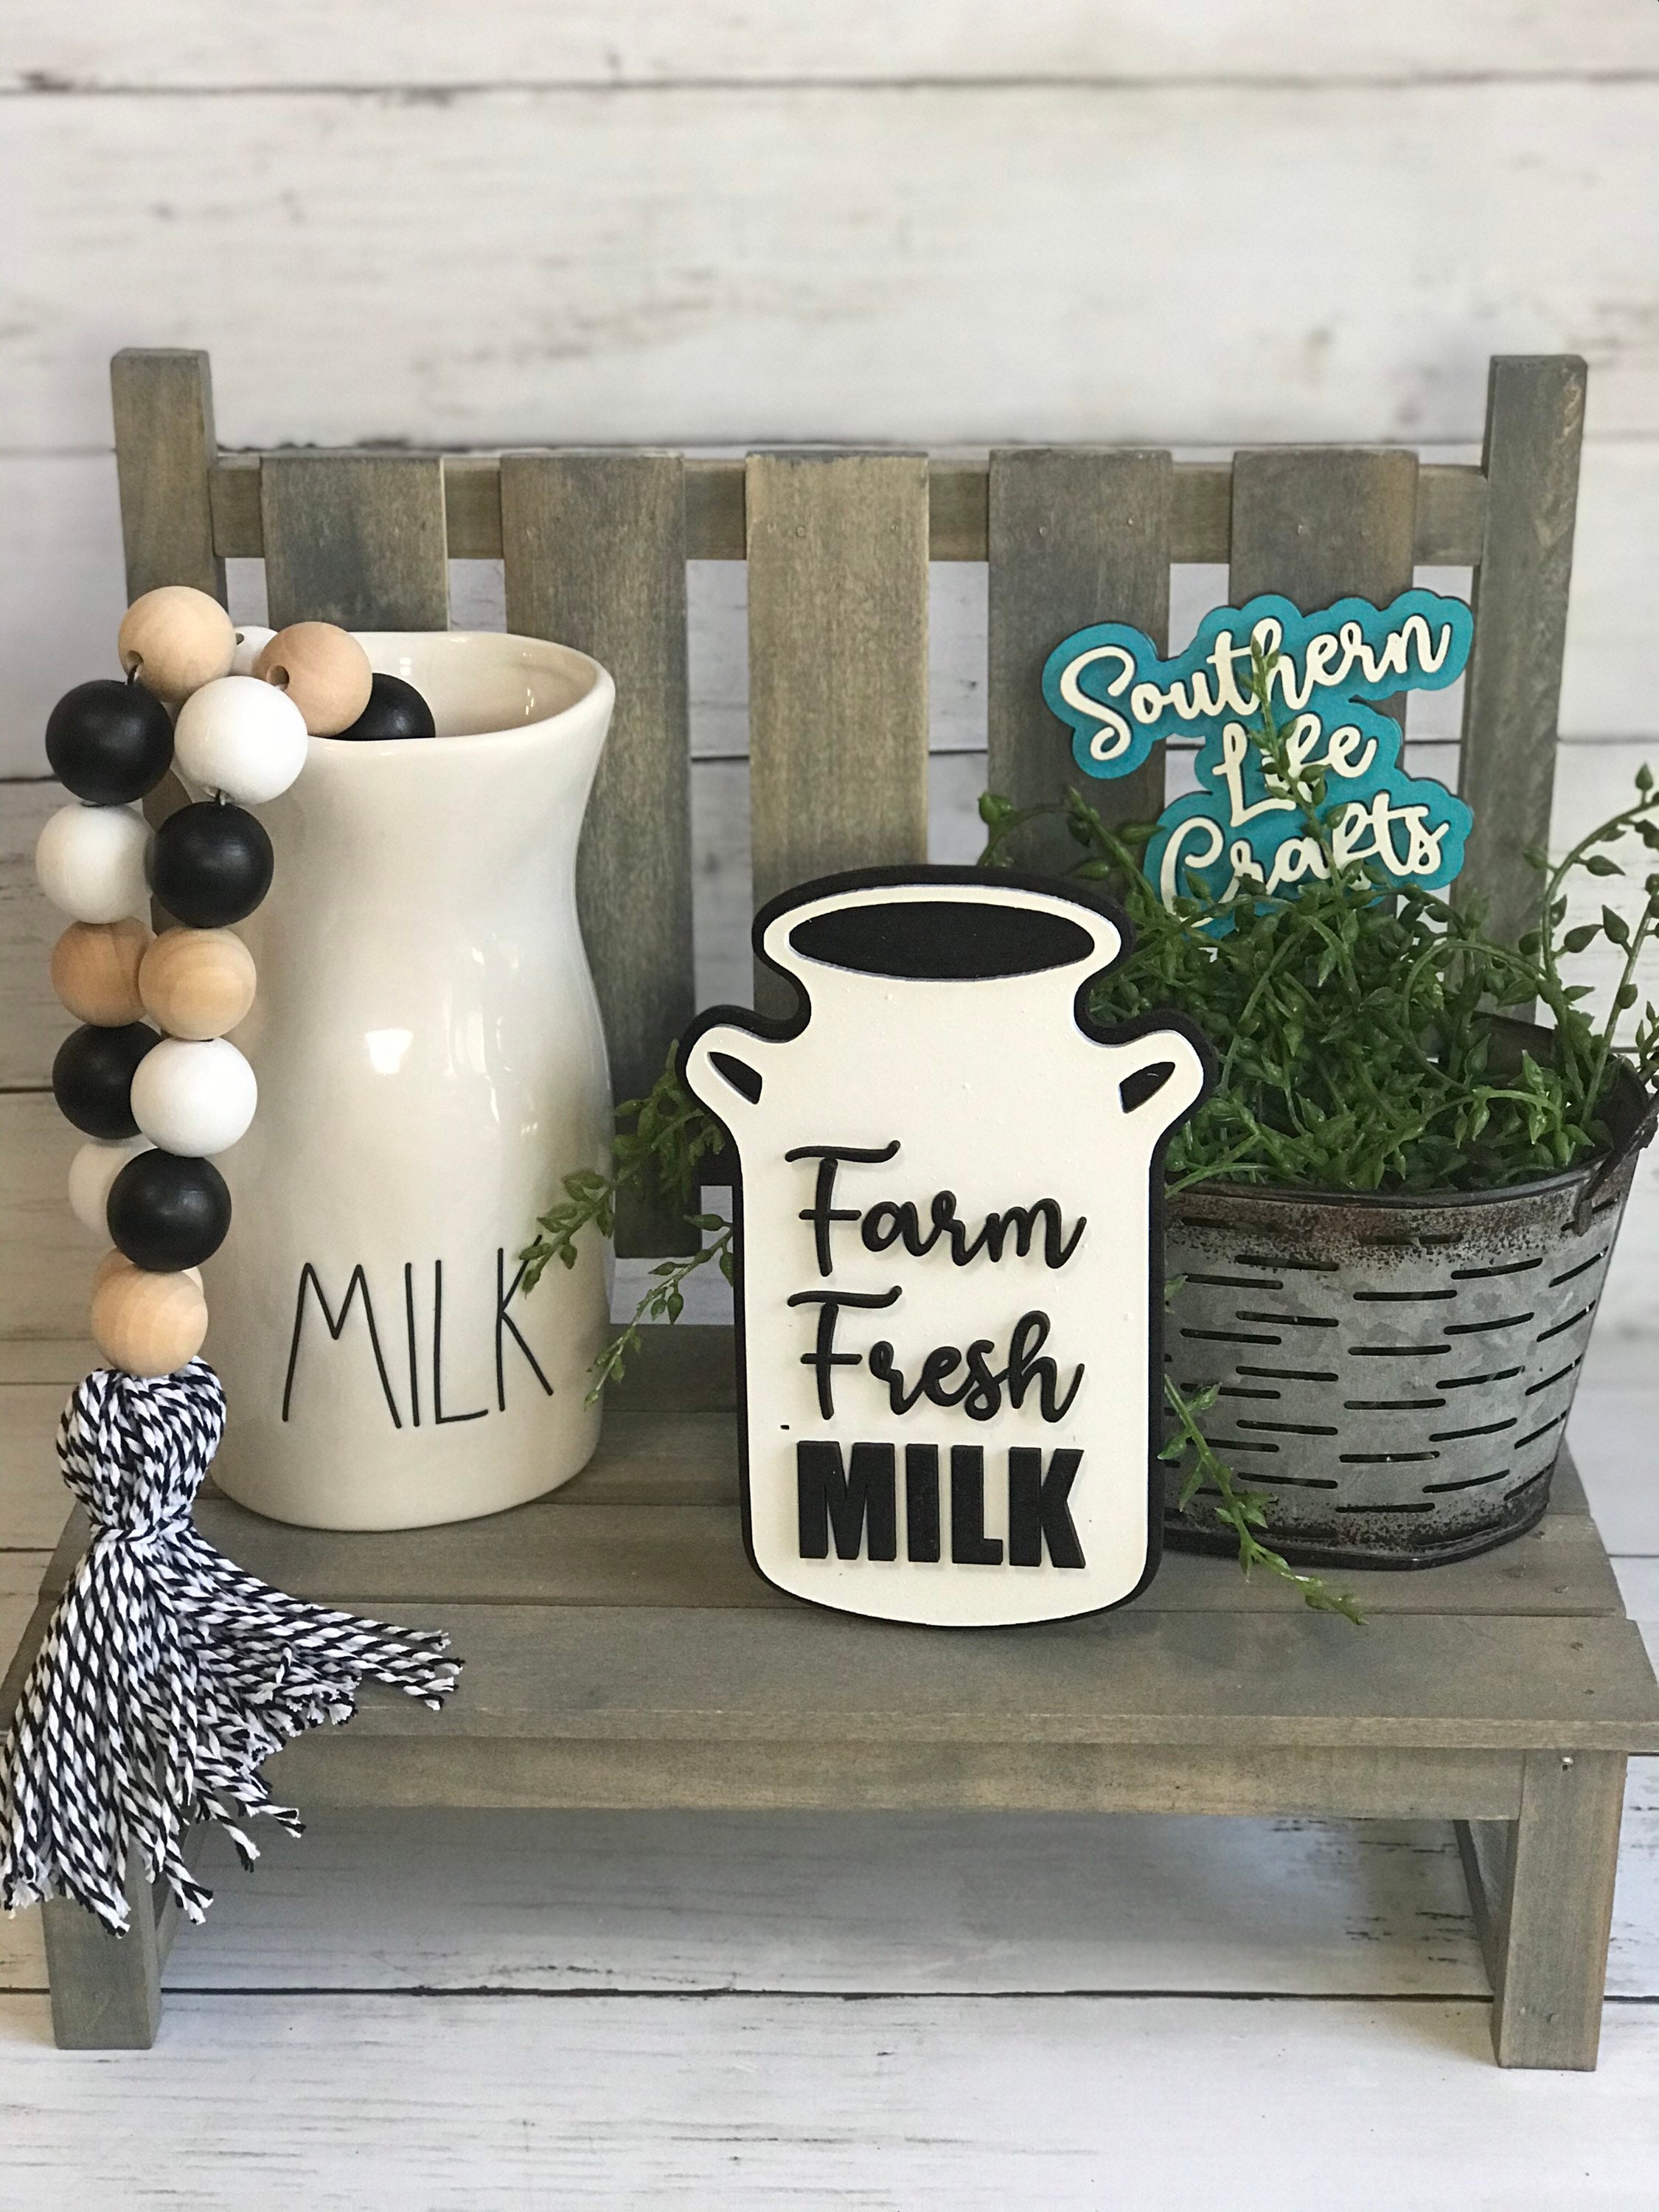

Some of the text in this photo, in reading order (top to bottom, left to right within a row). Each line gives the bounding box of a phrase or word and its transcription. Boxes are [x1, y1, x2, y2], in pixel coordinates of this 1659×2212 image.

[1060, 616, 1450, 761] Southern
[785, 1140, 1087, 1276] Farm
[282, 1235, 554, 1428] MILK
[787, 1286, 1086, 1423] Fresh
[797, 1441, 1085, 1568] MILK
